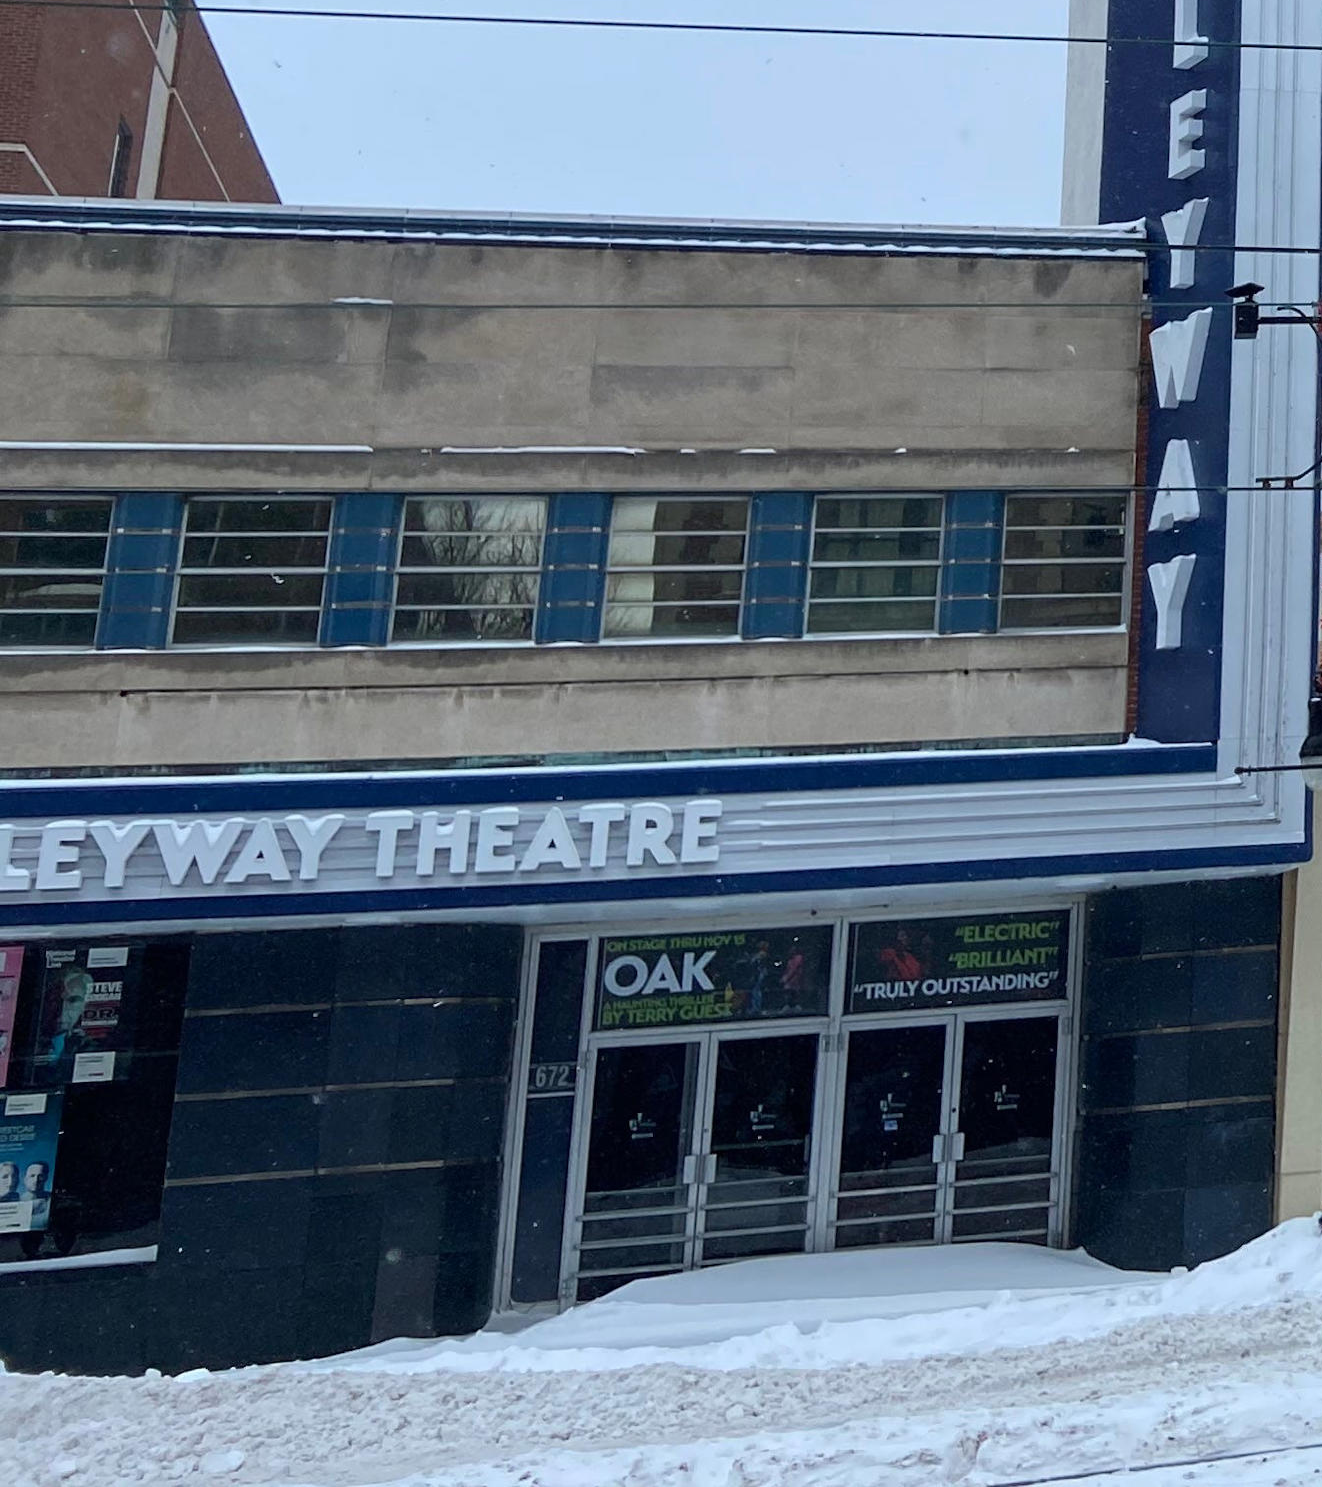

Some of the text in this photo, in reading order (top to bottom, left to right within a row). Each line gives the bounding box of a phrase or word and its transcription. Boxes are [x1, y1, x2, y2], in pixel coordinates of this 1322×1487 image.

[366, 798, 722, 877] THEATRE
[604, 950, 717, 997] OAK
[602, 1010, 623, 1026] BY
[627, 1007, 678, 1024] TERRY
[535, 1065, 570, 1088] 672
